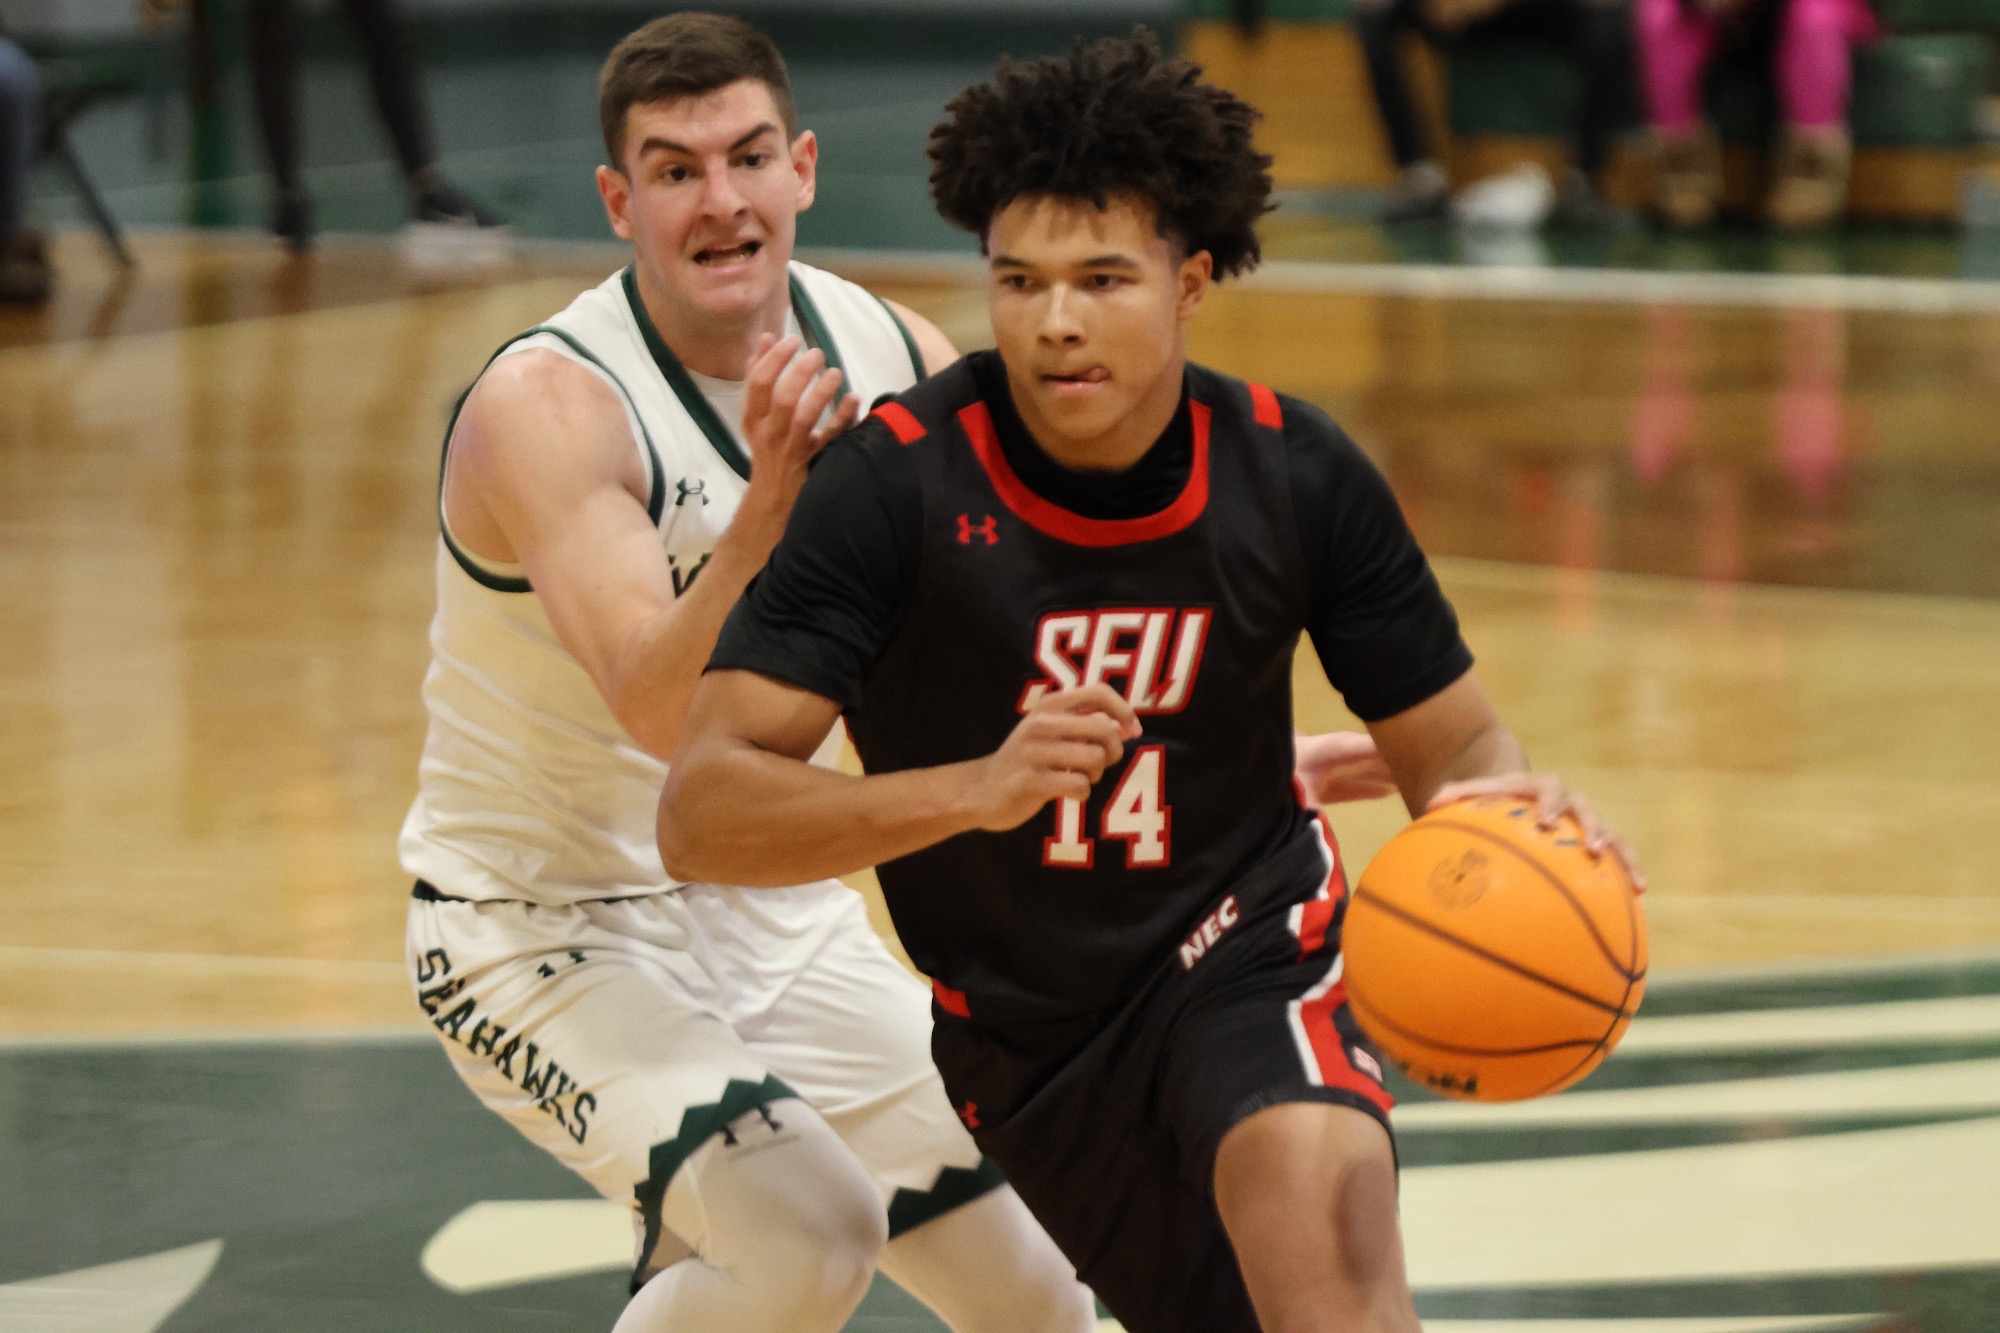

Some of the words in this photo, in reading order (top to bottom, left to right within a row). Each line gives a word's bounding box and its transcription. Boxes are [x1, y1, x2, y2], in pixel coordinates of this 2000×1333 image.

[1015, 608, 1213, 715] SFU
[1042, 745, 1171, 869] 14
[1179, 895, 1239, 970] NEC
[417, 948, 596, 1145] SEAHAWKS
